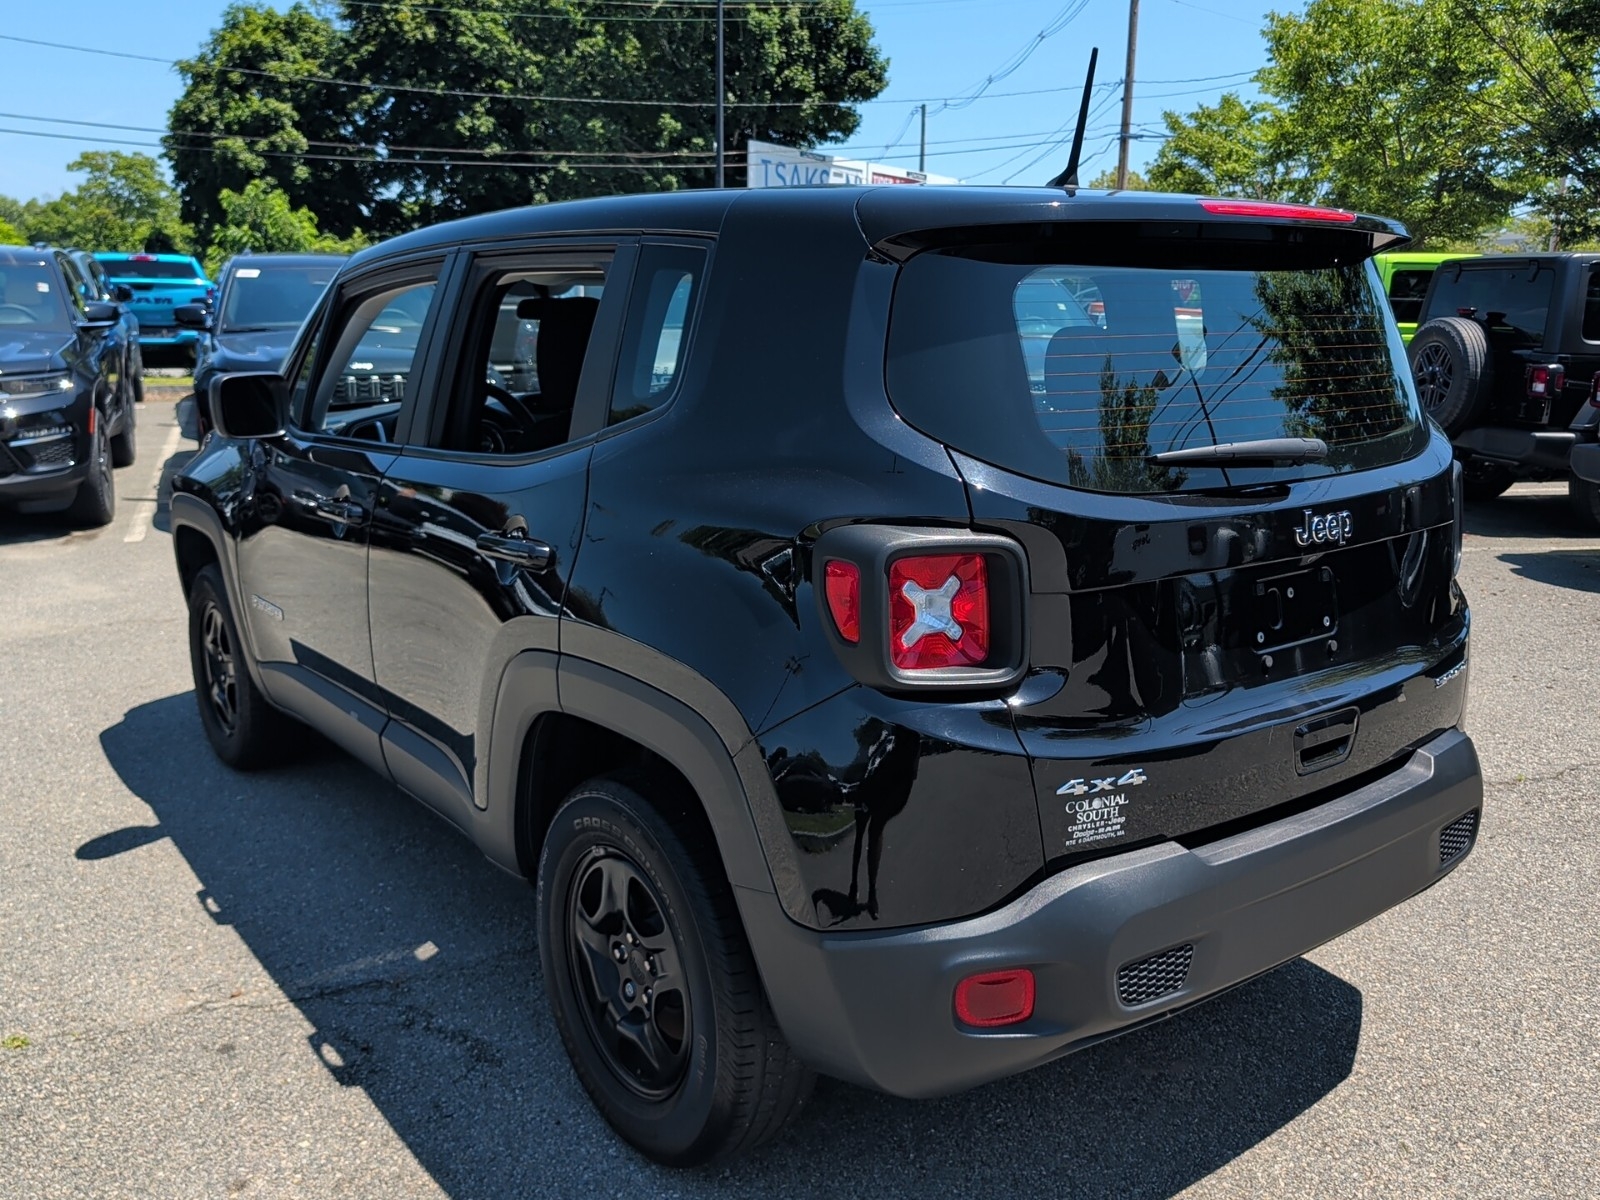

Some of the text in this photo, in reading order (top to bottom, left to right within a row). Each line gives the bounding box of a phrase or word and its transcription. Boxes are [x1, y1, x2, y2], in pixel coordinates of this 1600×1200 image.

[1293, 509, 1353, 547] Jeep
[1056, 768, 1148, 796] 4x4
[1065, 793, 1129, 814] COLONIAL
[1076, 806, 1120, 824] SOUTH
